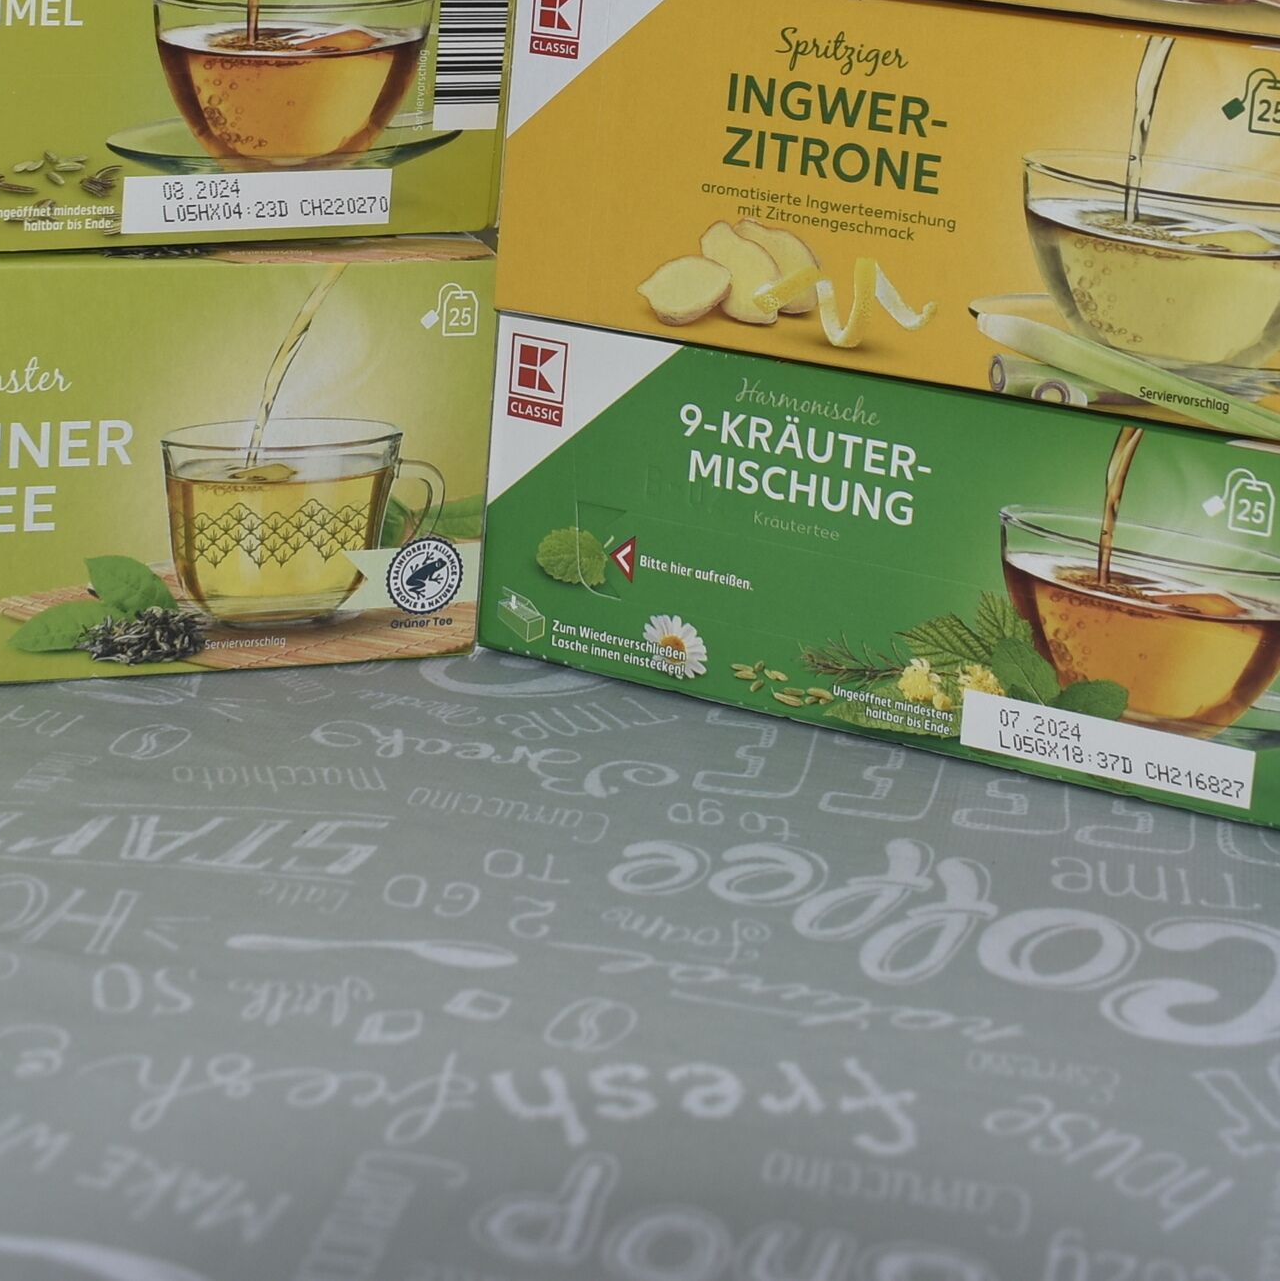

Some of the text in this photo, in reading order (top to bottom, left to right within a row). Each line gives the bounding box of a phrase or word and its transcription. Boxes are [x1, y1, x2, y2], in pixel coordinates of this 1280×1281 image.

[532, 40, 576, 55] CLASSIC
[775, 26, 908, 77] Spritziger
[727, 72, 948, 138] INGWER-
[722, 126, 942, 195] ZITRONE
[162, 179, 241, 201] 08.2024
[701, 182, 956, 231] aromatisierte Ingwerteemischung
[24, 218, 113, 232] haltbar bis Ende:
[53, 204, 115, 217] mindestens
[163, 195, 389, 223] L05HX04:23D CH220270
[737, 204, 915, 240] mit Zitronengeschmack
[449, 307, 471, 327] 25
[510, 401, 560, 422] CLASSIC
[735, 377, 880, 427] Harmonische
[1139, 386, 1230, 415] Serviervorschlag
[679, 403, 932, 482] 9-KRÄUTER-
[688, 449, 914, 526] MISCHUNG
[753, 510, 840, 541] Kräutertee
[1236, 498, 1266, 524] 25
[392, 543, 457, 580] RAINFOREST ALLIANCE
[640, 555, 754, 591] Bitte hier aufreißen.
[394, 586, 418, 608] PEOPLE
[428, 583, 454, 608] NATURE
[391, 617, 430, 628] Grüner
[204, 635, 286, 650] Serviervorschlag
[551, 634, 686, 676] Lasche innen einstecken!
[552, 619, 686, 662] Zum Wiederverschließen
[833, 684, 954, 722] Ungeöffnet mindestens
[865, 706, 953, 736] haltbar bis Ende:
[998, 708, 1082, 743] 07.2024
[997, 729, 1246, 799] L05GX18:37D CH216827
[492, 1057, 916, 1159] fresh
